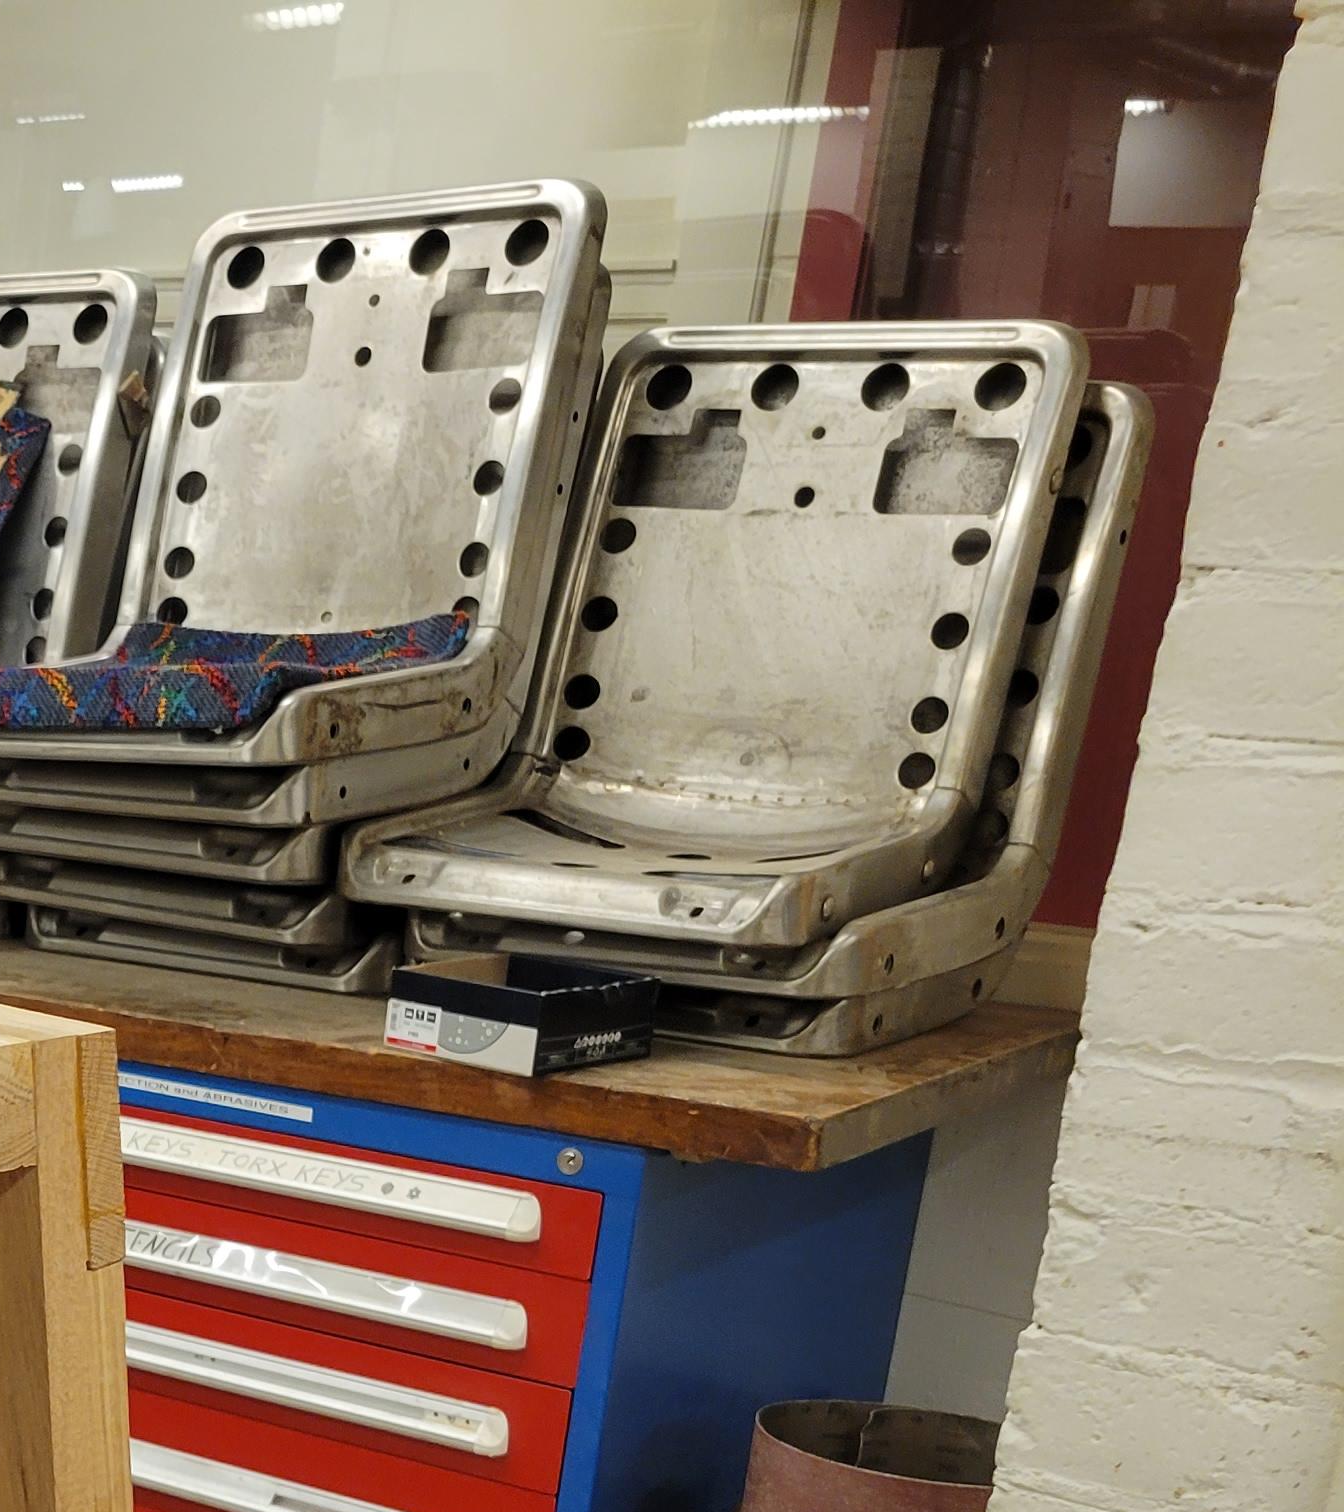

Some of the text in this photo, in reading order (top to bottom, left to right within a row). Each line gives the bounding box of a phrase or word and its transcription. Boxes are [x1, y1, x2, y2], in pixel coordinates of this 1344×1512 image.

[203, 1090, 290, 1114] ABRASIVES
[126, 1130, 373, 1194] KEYS TORX KEYS
[126, 1228, 218, 1268] ENCILS
